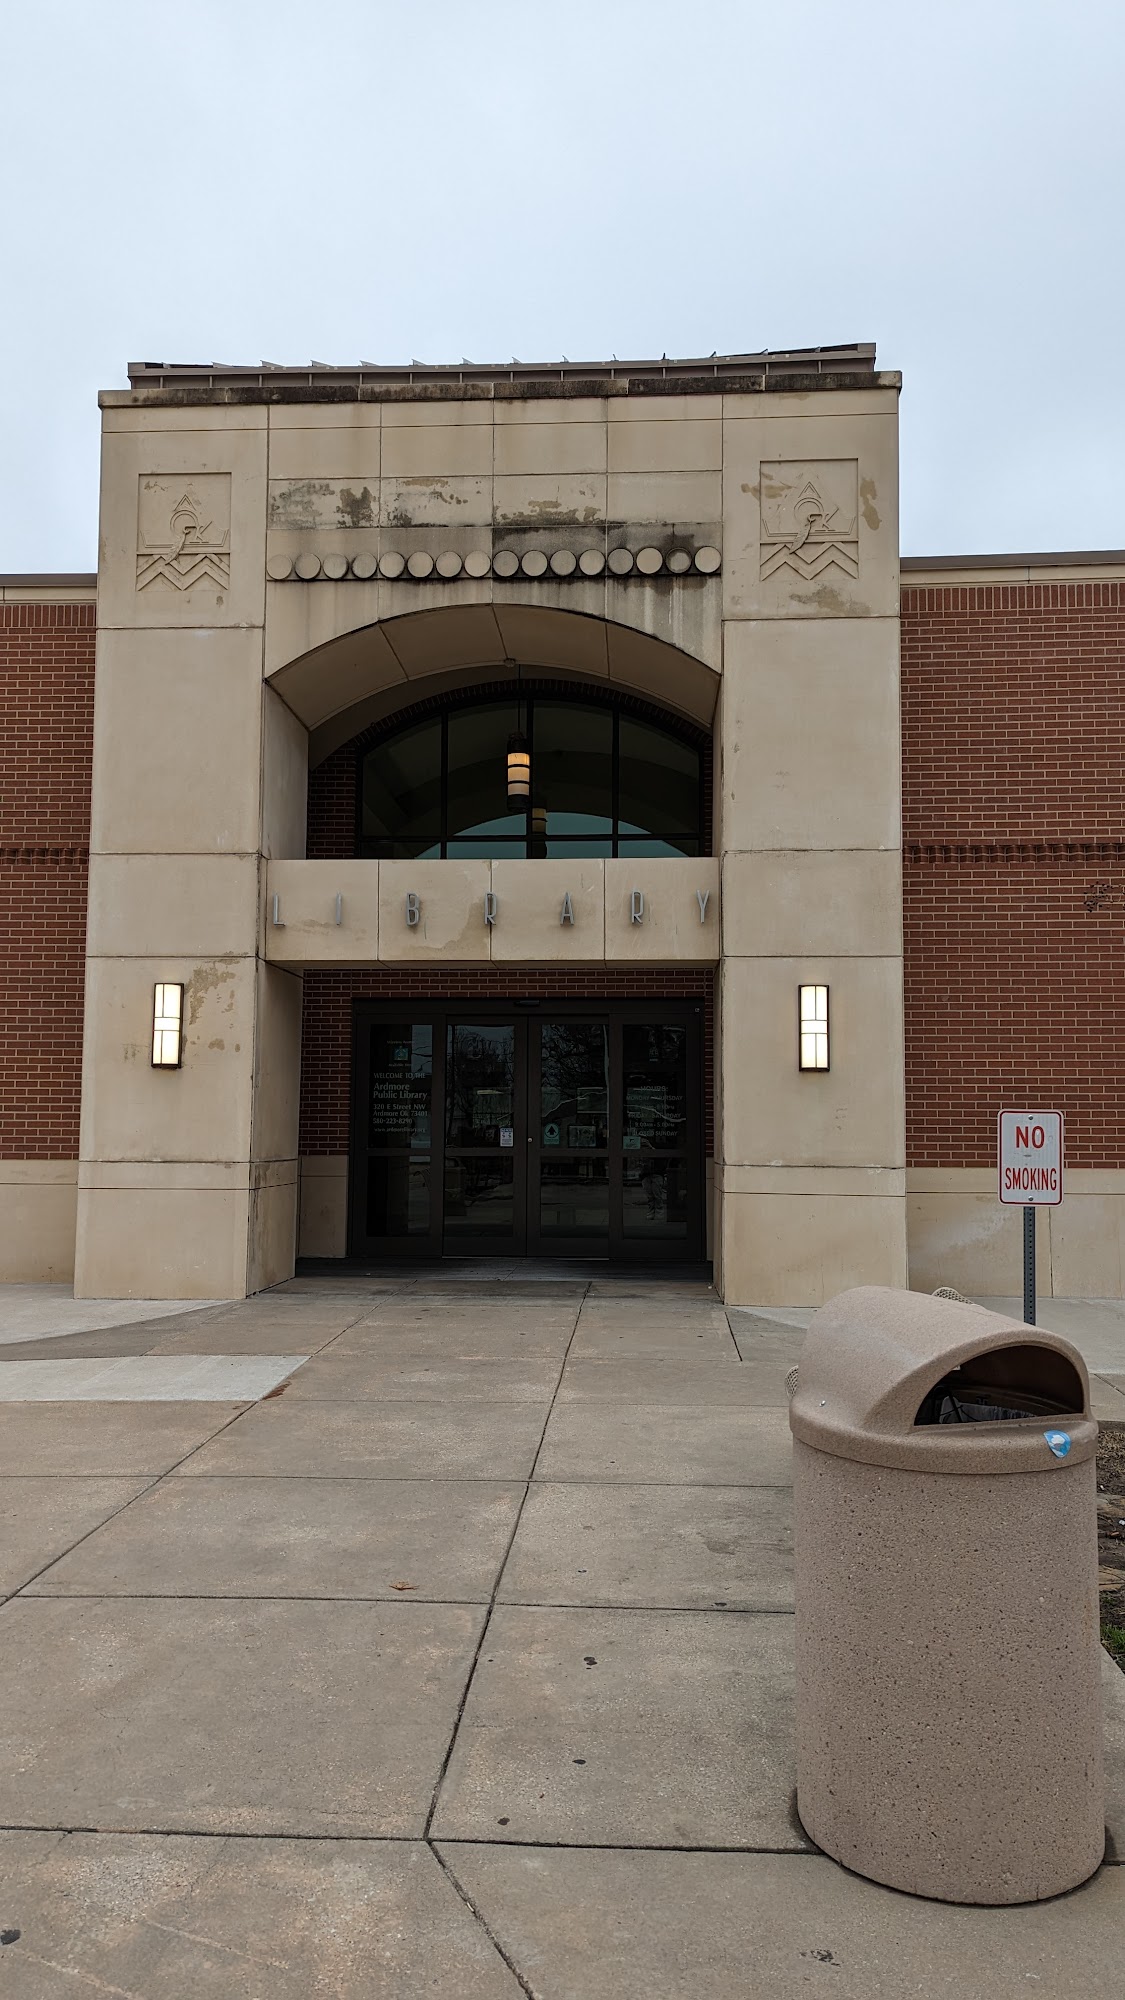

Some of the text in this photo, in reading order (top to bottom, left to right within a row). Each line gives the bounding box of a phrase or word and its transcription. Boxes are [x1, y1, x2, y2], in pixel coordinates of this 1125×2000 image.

[272, 889, 710, 928] LIBRARY
[373, 1081, 410, 1090] Ardmore
[373, 1090, 428, 1101] Public Library
[1016, 1125, 1045, 1149] NO
[1005, 1167, 1057, 1191] SMOKING
